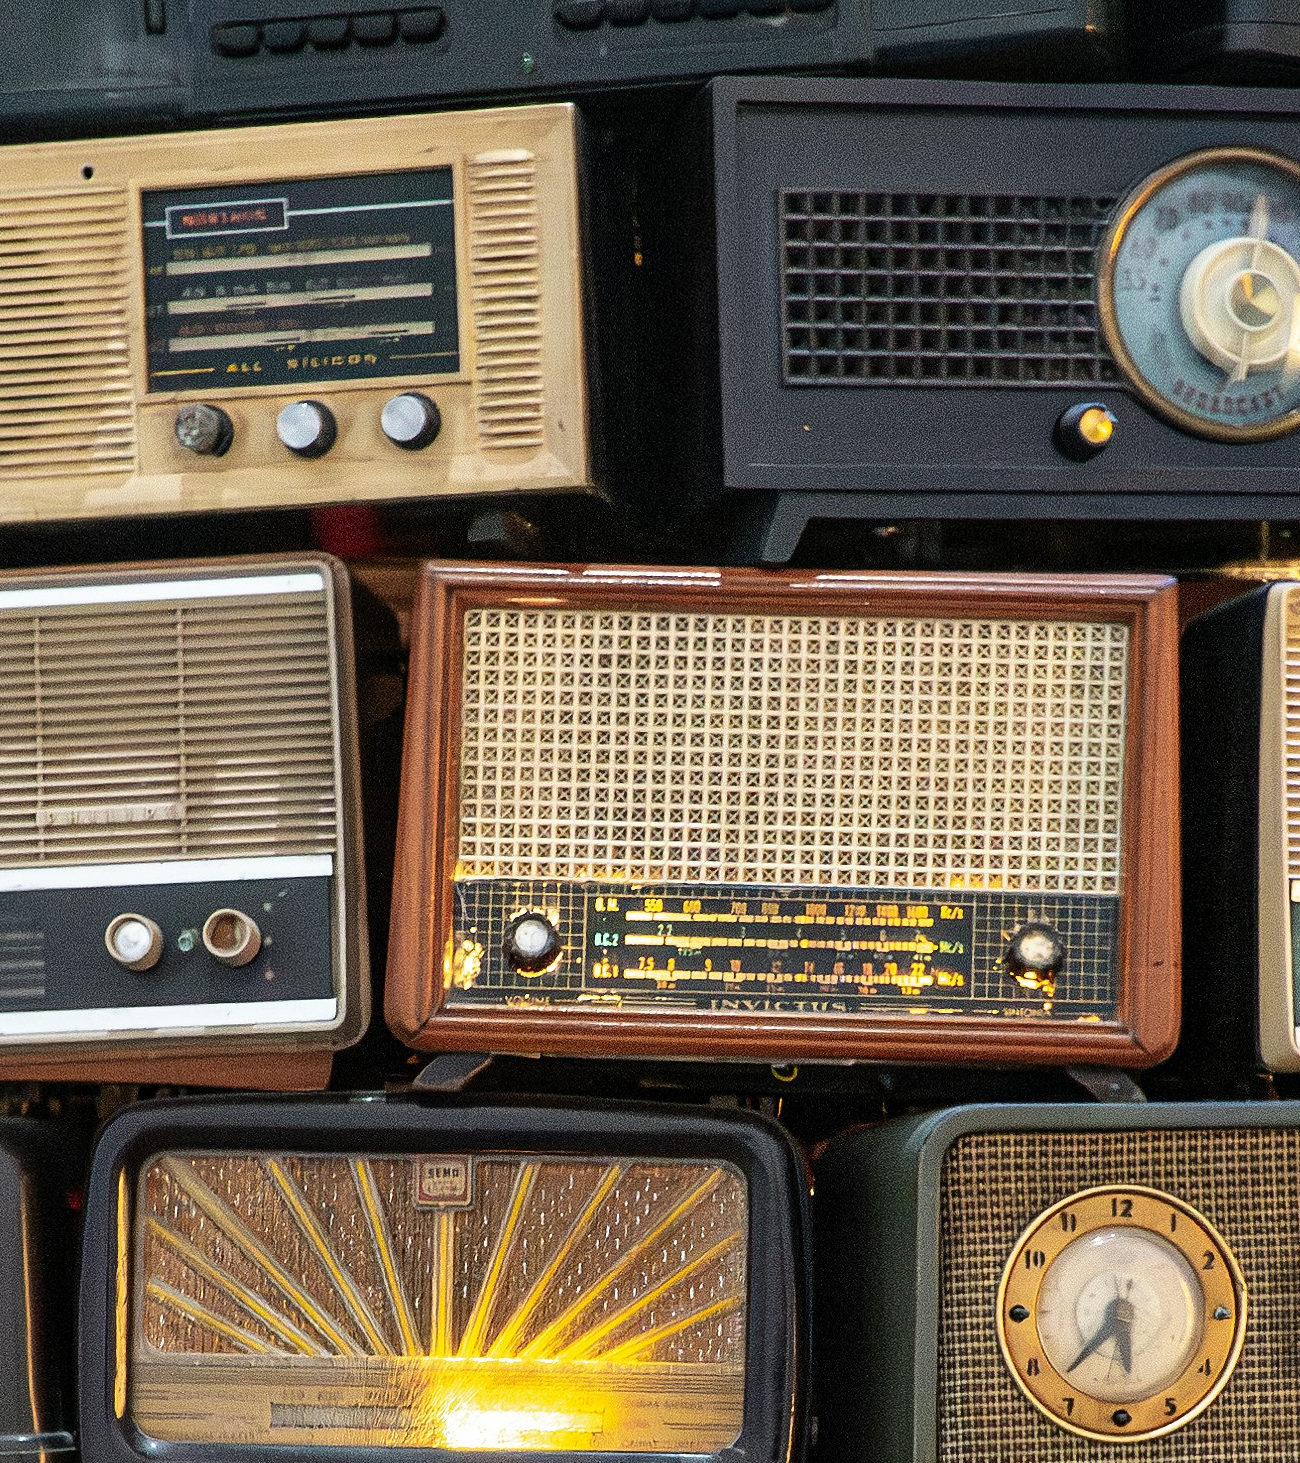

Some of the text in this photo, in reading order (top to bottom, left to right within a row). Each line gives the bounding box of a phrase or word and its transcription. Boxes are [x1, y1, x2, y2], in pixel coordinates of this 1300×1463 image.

[710, 997, 849, 1014] INVICTUS
[1111, 1197, 1134, 1218] 12
[1059, 1212, 1077, 1232] 11
[1170, 1213, 1177, 1232] 1
[1024, 1249, 1046, 1269] 10
[1202, 1251, 1215, 1270] 2
[1027, 1358, 1040, 1377] 8
[1198, 1358, 1212, 1376] 4
[1062, 1398, 1075, 1416] 7
[1164, 1398, 1177, 1416] 5
